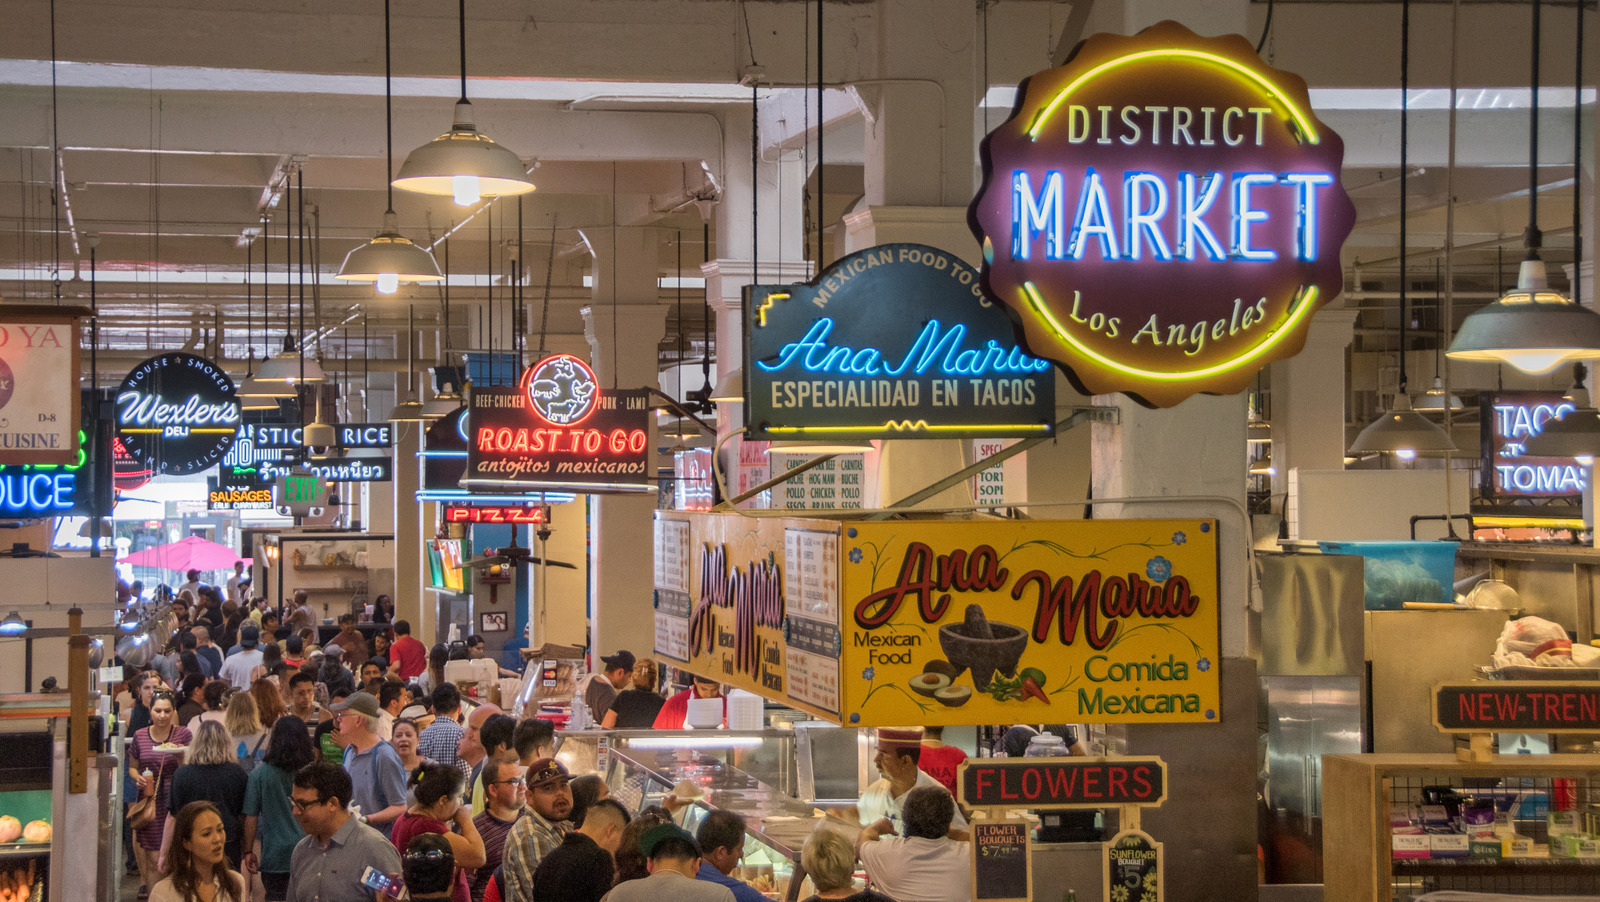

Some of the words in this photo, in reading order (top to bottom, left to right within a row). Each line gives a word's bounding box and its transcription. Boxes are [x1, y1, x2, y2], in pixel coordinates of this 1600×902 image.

[1067, 105, 1272, 145] DISTRICT
[1012, 167, 1333, 262] MARKET
[812, 249, 894, 309] MEXICAN
[899, 249, 948, 270] FOOD
[951, 262, 972, 285] TO
[1069, 290, 1121, 338] Los
[1131, 297, 1267, 356] Angeles
[17, 325, 63, 348] YA
[755, 317, 881, 376] Ana
[129, 358, 167, 387] HOUSE
[188, 358, 229, 392] SMOKED
[476, 395, 492, 408] BEEF
[495, 395, 525, 408] CHICKEN
[597, 397, 617, 409] PORK
[626, 397, 646, 409] LAMB
[771, 380, 919, 408] ESPECIALIDAD
[932, 379, 958, 406] EN
[970, 378, 1036, 406] TACOS
[38, 413, 56, 422] D-8
[116, 390, 239, 425] Wexler's
[0, 433, 60, 448] UISINE
[163, 426, 189, 438] DELI
[258, 428, 302, 445] STIC
[343, 427, 389, 444] RICE
[477, 427, 562, 453] ROAST
[570, 428, 601, 453] TO
[609, 428, 647, 454] GO
[125, 436, 167, 469] HAND
[187, 437, 229, 469] SLICED
[477, 456, 550, 478] antojitos
[556, 457, 645, 474] mexicanos
[841, 460, 863, 470] CARNITAS
[285, 477, 318, 502] EXIT
[808, 474, 820, 484] HOG
[822, 474, 835, 484] MAW
[841, 474, 858, 484] BUCHE
[210, 489, 271, 503] SAUSAGES
[786, 488, 805, 498] POLLO
[810, 488, 835, 498] CHICKEN
[841, 488, 859, 498] POLLO
[447, 507, 543, 522] PIZZA
[854, 541, 1009, 630] Ana
[1011, 564, 1199, 650] Maria
[718, 625, 735, 648] Mexican
[854, 631, 921, 647] Mexican
[722, 652, 733, 676] Food
[763, 639, 780, 666] Comida
[869, 649, 912, 664] Food
[762, 662, 782, 692] Mexicana
[1084, 654, 1189, 682] Comida
[1078, 687, 1200, 715] Mexicana
[976, 766, 1151, 799] FLOWERS
[977, 825, 1017, 836] FLOWER
[979, 835, 1025, 845] BOUQUETS
[1110, 849, 1156, 859] SUNFLOWER
